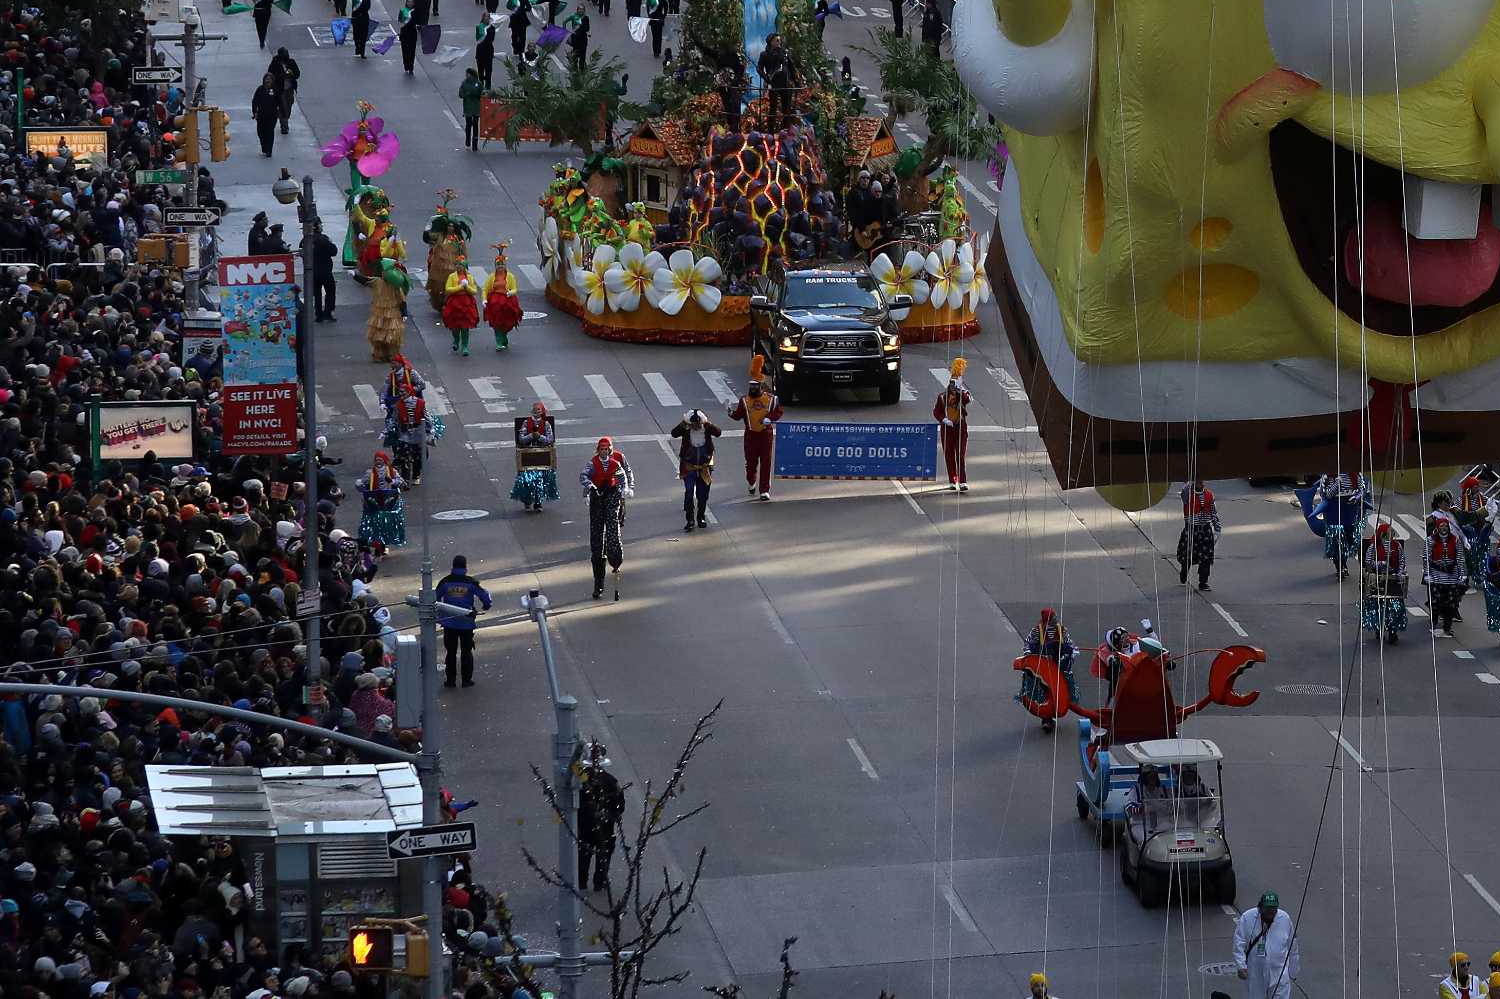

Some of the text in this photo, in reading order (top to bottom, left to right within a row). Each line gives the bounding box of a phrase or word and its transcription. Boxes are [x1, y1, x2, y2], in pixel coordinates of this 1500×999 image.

[160, 71, 177, 79] WAY
[168, 213, 213, 222] ONE WAY
[226, 262, 287, 285] NYC
[230, 389, 291, 401] SEE IT LIVE
[246, 404, 276, 415] HERE
[239, 418, 281, 429] IN NYC!
[107, 429, 124, 440] YOU
[124, 426, 138, 435] GET
[789, 425, 817, 433] MACY'S
[820, 425, 876, 433] THANKSGIVING
[896, 426, 926, 434] PARADE
[805, 446, 908, 458] GOO GOO DOLLS
[400, 831, 467, 850] ONE WAY
